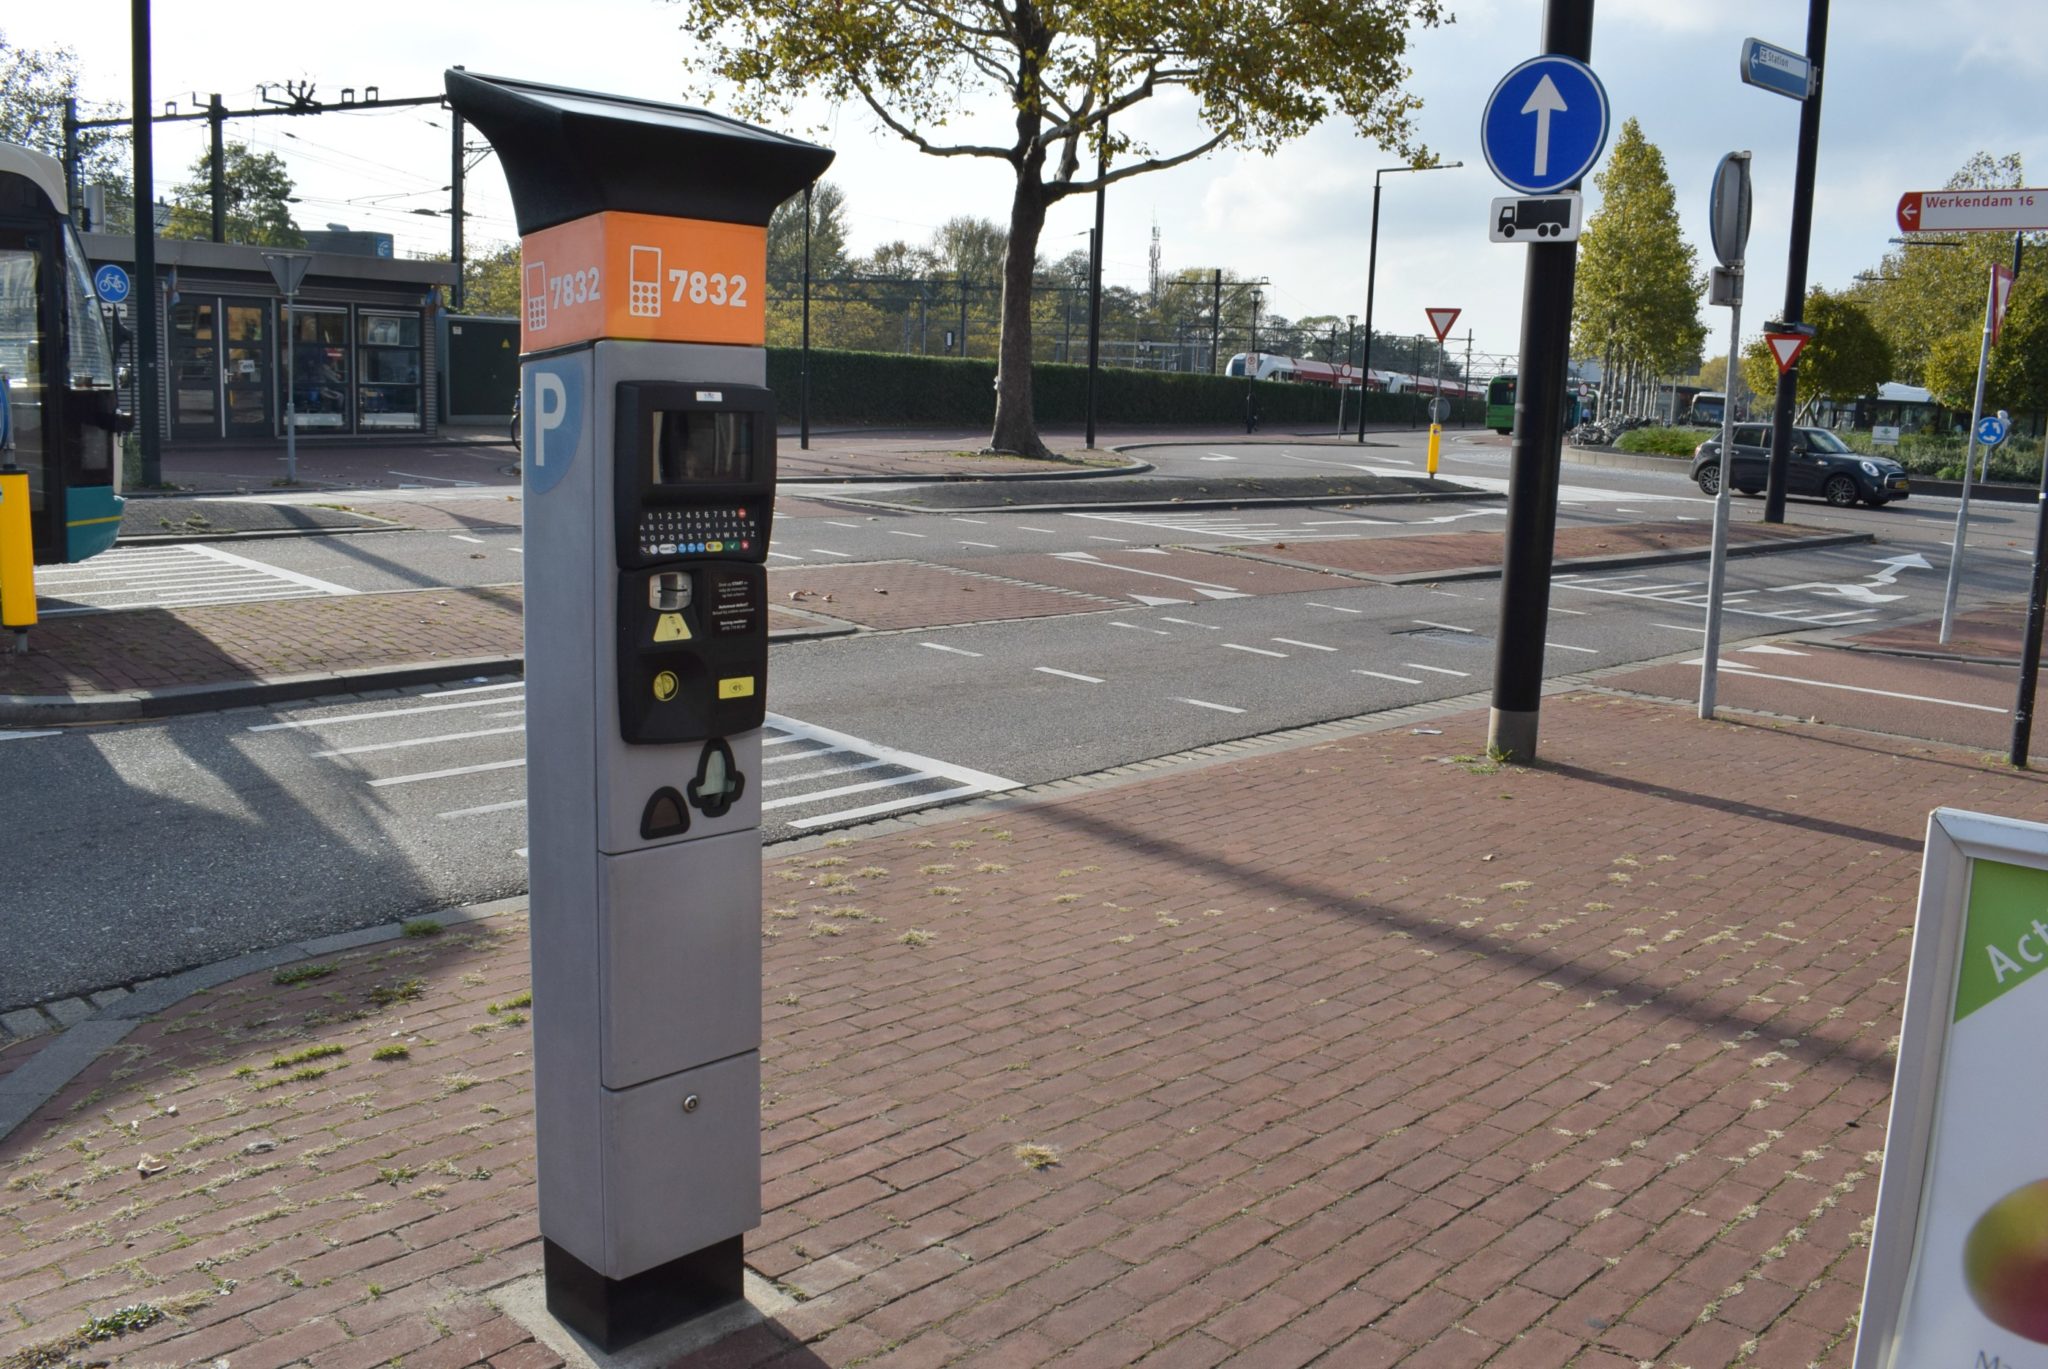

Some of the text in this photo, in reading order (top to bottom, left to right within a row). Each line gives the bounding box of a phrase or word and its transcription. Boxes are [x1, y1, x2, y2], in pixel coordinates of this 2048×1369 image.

[1768, 51, 1790, 68] Station
[1926, 195, 2034, 208] Werkendam 16
[550, 267, 600, 310] 7832
[668, 268, 748, 307] 7832
[536, 372, 566, 466] P
[1985, 908, 2048, 984] Act
